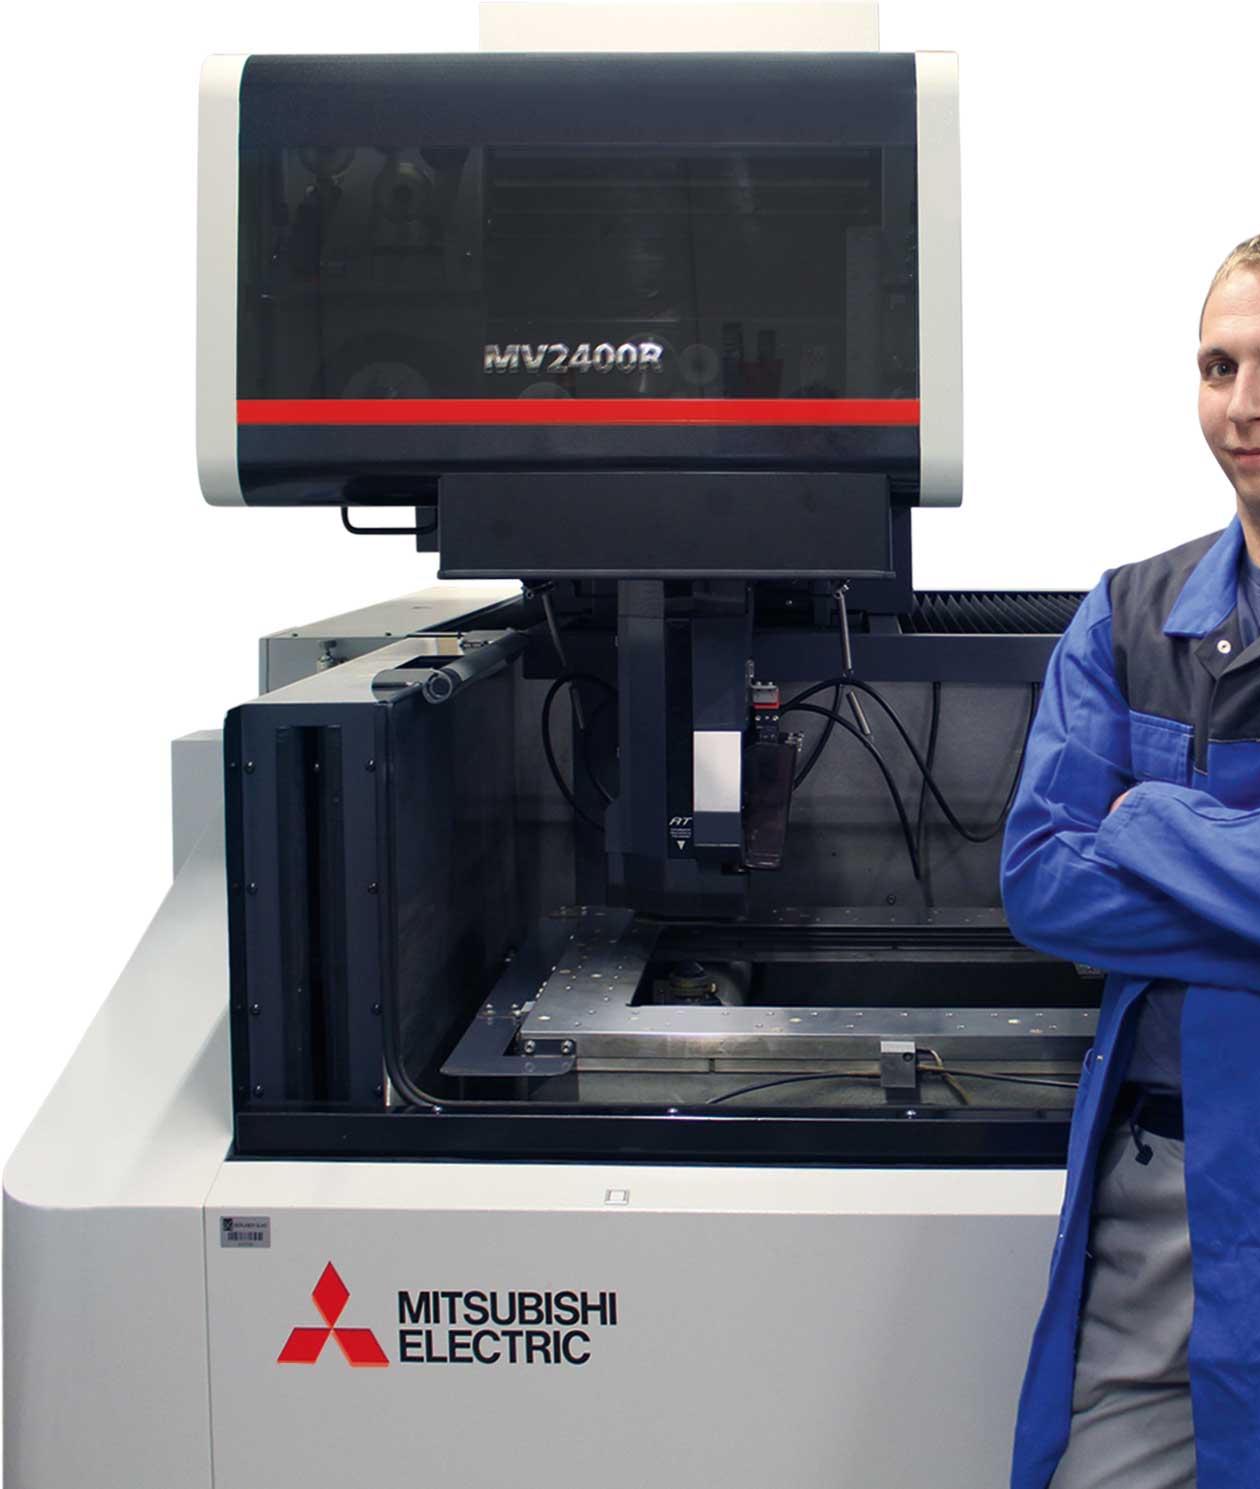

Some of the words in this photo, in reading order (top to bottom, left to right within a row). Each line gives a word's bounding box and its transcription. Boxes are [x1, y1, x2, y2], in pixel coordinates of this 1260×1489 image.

[484, 343, 664, 374] MV2400R
[397, 1290, 618, 1327] MITSUBISHI
[399, 1329, 592, 1365] ELECTRIC
